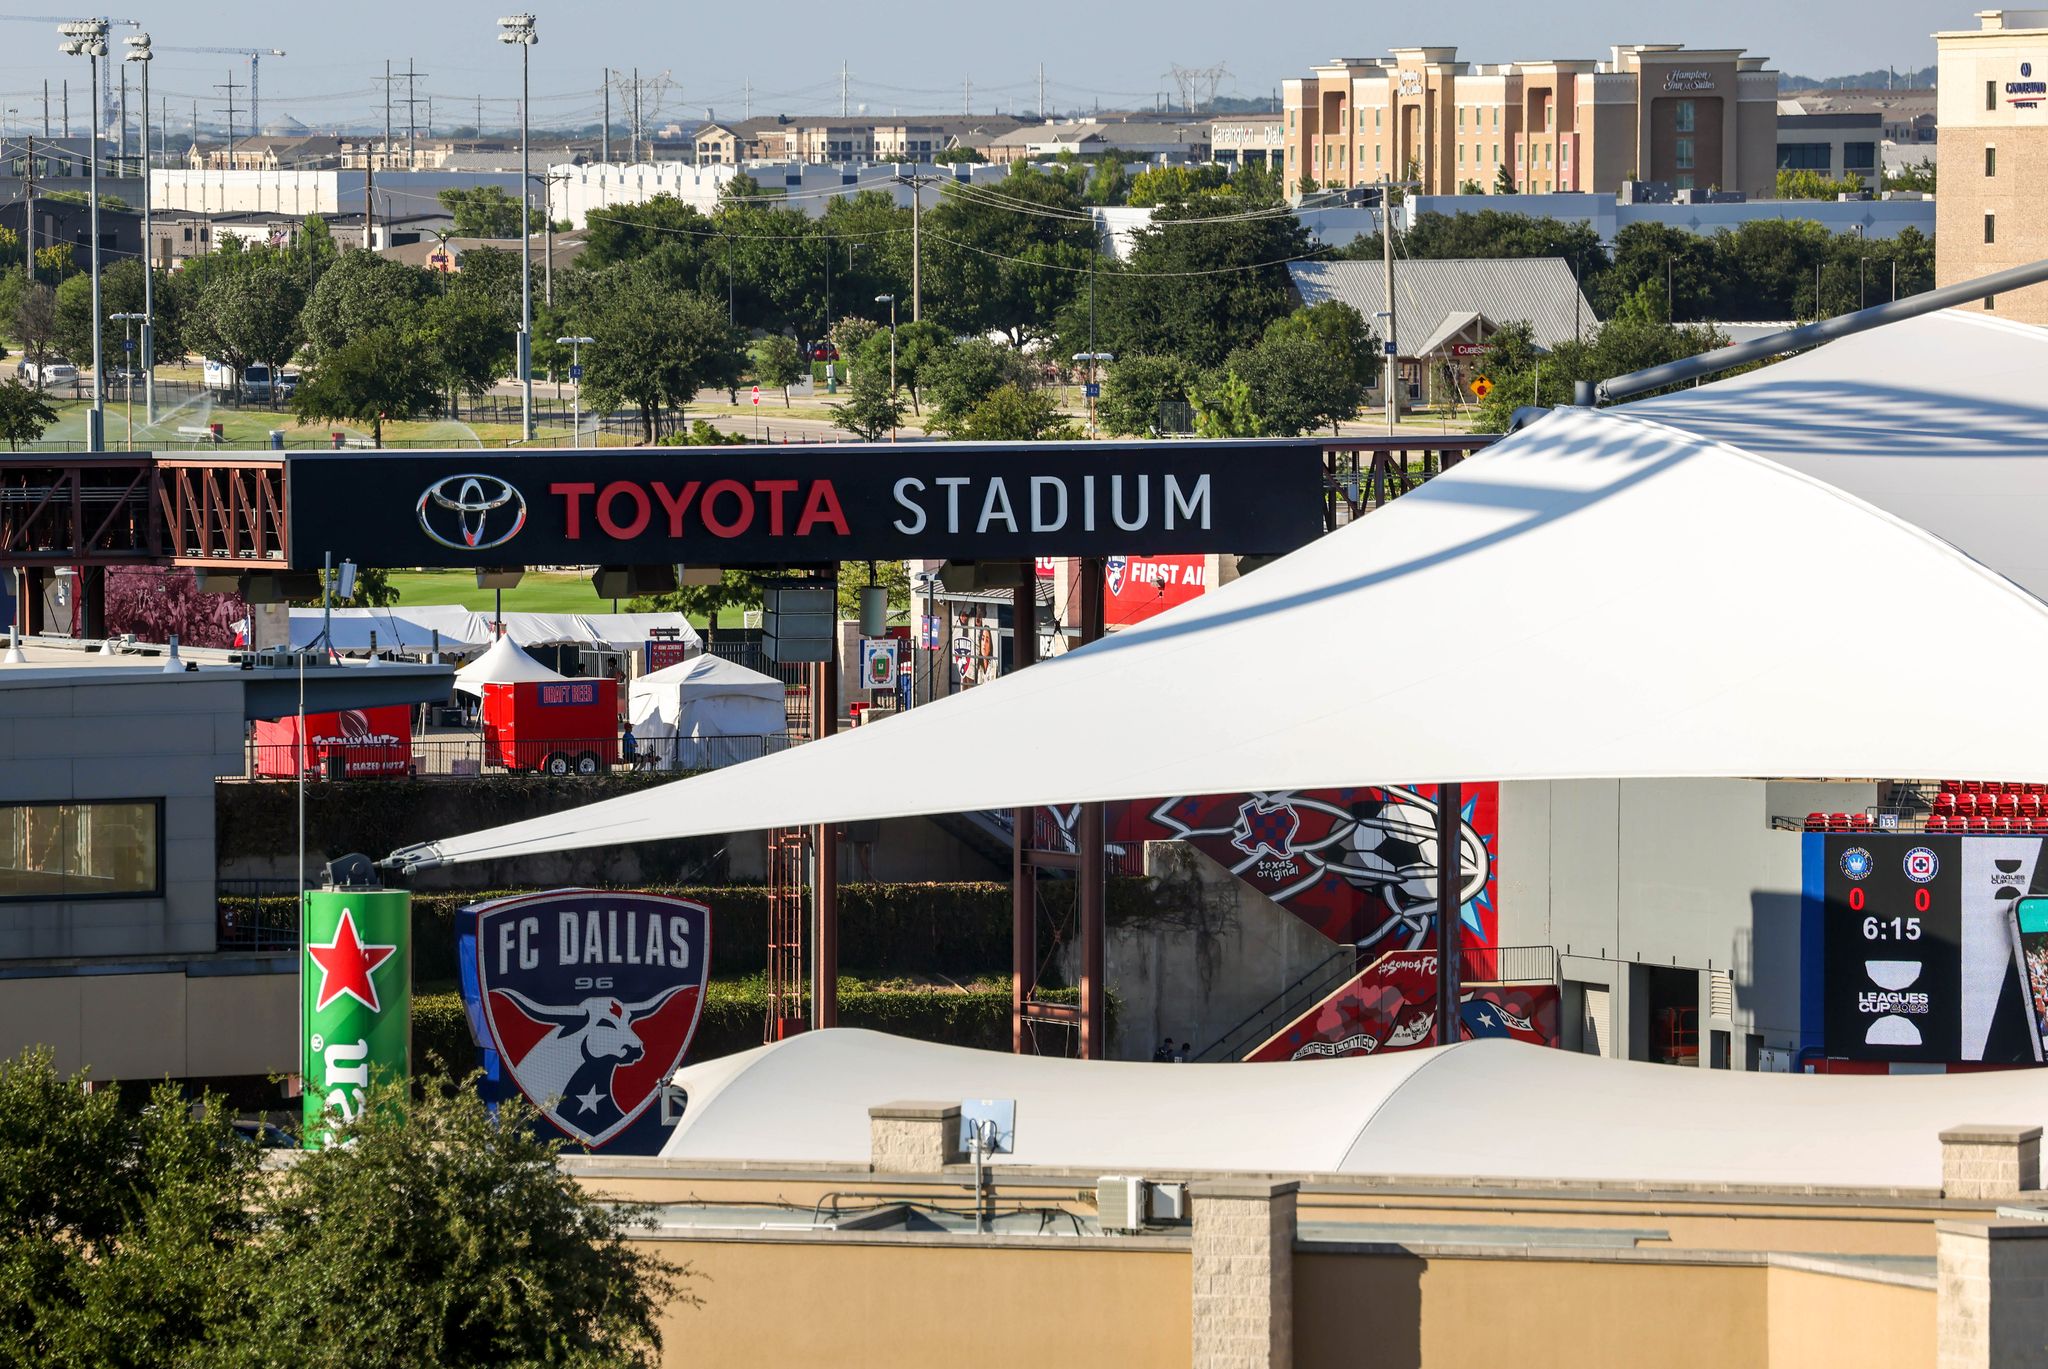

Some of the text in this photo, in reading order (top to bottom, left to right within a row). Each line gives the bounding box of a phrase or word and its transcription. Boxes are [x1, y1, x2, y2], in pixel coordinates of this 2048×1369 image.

[1667, 70, 1711, 81] Hampton
[1212, 124, 1255, 147] Careington
[550, 473, 1212, 540] TOYOTA STADIUM
[1131, 562, 1179, 585] FIRST
[543, 685, 592, 703] DRAFT BEER
[1882, 818, 1895, 827] 133
[1256, 865, 1299, 882] original
[1258, 860, 1293, 870] texas
[1849, 887, 1931, 912] 0 0
[1863, 916, 1922, 940] 6:15
[499, 910, 690, 975] FC DALLAS
[575, 977, 614, 990] 96
[1858, 992, 1929, 1003] LEAGUES
[1858, 1002, 1891, 1013] CUP
[1296, 1043, 1334, 1059] SIEMPRE
